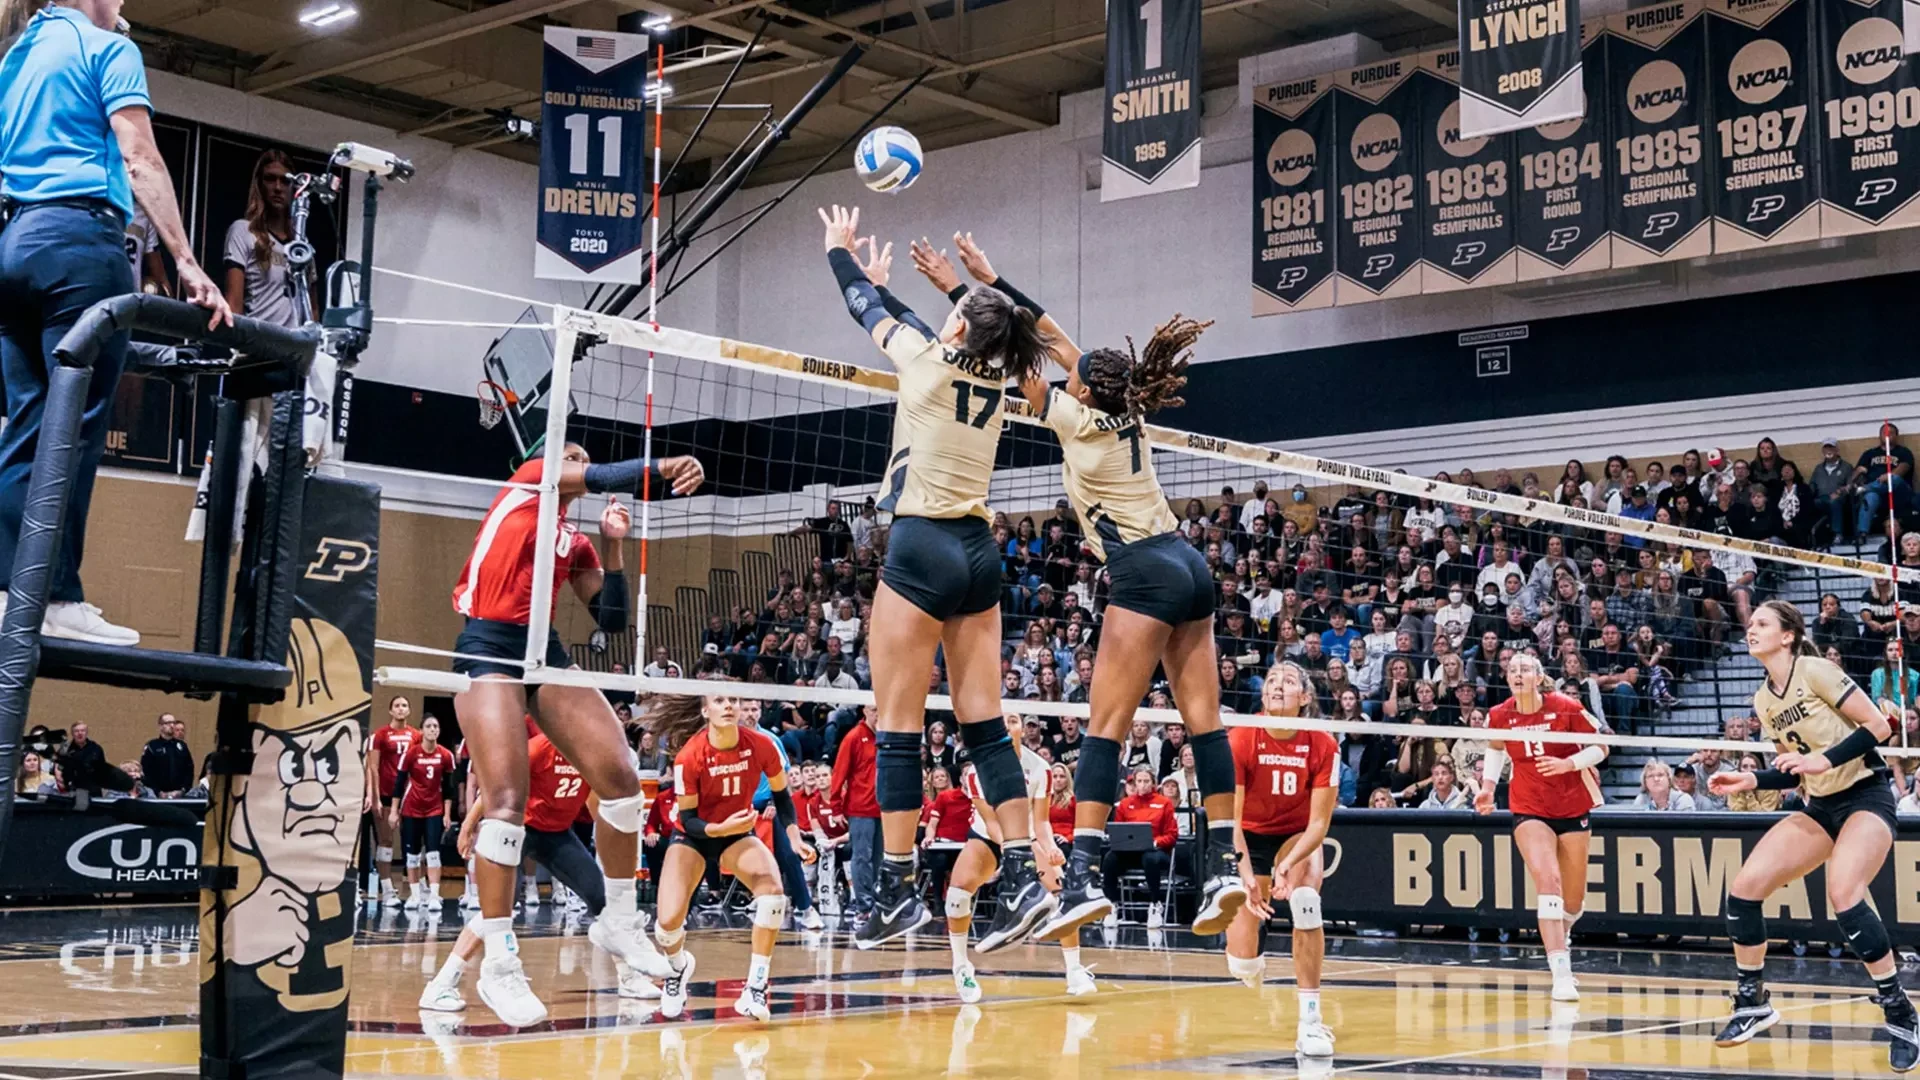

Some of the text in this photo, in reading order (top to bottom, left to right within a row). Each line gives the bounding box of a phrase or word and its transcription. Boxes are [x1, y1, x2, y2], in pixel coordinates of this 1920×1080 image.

[1486, 0, 1538, 13] STEPH
[1626, 4, 1684, 31] PURDUE
[1140, 0, 1162, 70] 1
[1470, 0, 1566, 51] LYNCH
[1844, 45, 1901, 70] NCAA
[1126, 71, 1176, 89] MARIANNE
[1351, 62, 1400, 86] PURDUE
[1498, 68, 1542, 94] 2008
[1736, 66, 1789, 91] NCAA
[545, 91, 642, 111] GOLD MEDALIST
[1112, 79, 1190, 123] SMITH
[1268, 79, 1317, 101] PURDUE
[1634, 86, 1685, 110] NCAA
[1825, 87, 1920, 139] 1990
[1717, 105, 1807, 158] 1987
[564, 113, 622, 177] 11
[1134, 141, 1166, 163] 1985
[1356, 138, 1401, 160] NCAA
[1616, 125, 1700, 175] 1985
[1855, 134, 1893, 152] FIRST
[1272, 153, 1316, 174] NCAA
[1520, 142, 1602, 191] 1984
[1732, 150, 1796, 173] REGIONAL
[1851, 151, 1898, 171] ROUND
[576, 181, 607, 190] ANNIE
[1426, 160, 1507, 206] 1983
[1630, 168, 1688, 190] REGIONAL
[1725, 165, 1804, 190] SEMIFINALS
[544, 188, 636, 218] DREWS
[1341, 174, 1413, 219] 1982
[1546, 186, 1578, 204] FIRST
[1623, 183, 1697, 207] SEMIFINALS
[1261, 189, 1324, 232] 1981
[1439, 201, 1496, 221] REGIONAL
[1543, 201, 1582, 220] ROUND
[575, 229, 604, 238] TOKYO
[1352, 214, 1403, 234] REGIONAL
[1432, 215, 1503, 236] SEMIFINALS
[570, 238, 608, 254] 2020
[1267, 227, 1317, 247] REGIONAL
[1359, 230, 1397, 247] FINALS
[1261, 241, 1323, 261] SEMIFINALS
[802, 357, 857, 381] BOILER UP
[1487, 360, 1500, 371] 12
[951, 380, 1002, 430] 17
[1188, 434, 1227, 453] BOILER UP
[1317, 459, 1391, 486] PURDUE VOLLEYBALL
[1467, 488, 1497, 504] BOILER UP
[1564, 507, 1586, 522] PURDUE
[304, 537, 371, 582] P
[307, 680, 320, 704] P
[1771, 701, 1810, 731] PURDUE
[1523, 740, 1545, 757] 13
[1786, 731, 1811, 755] 3
[426, 765, 434, 779] 3
[1258, 754, 1307, 768] WISCONSIN
[554, 777, 582, 798] 22
[722, 776, 741, 796] 11
[1271, 769, 1297, 796] 18
[116, 868, 199, 882] HEALTH
